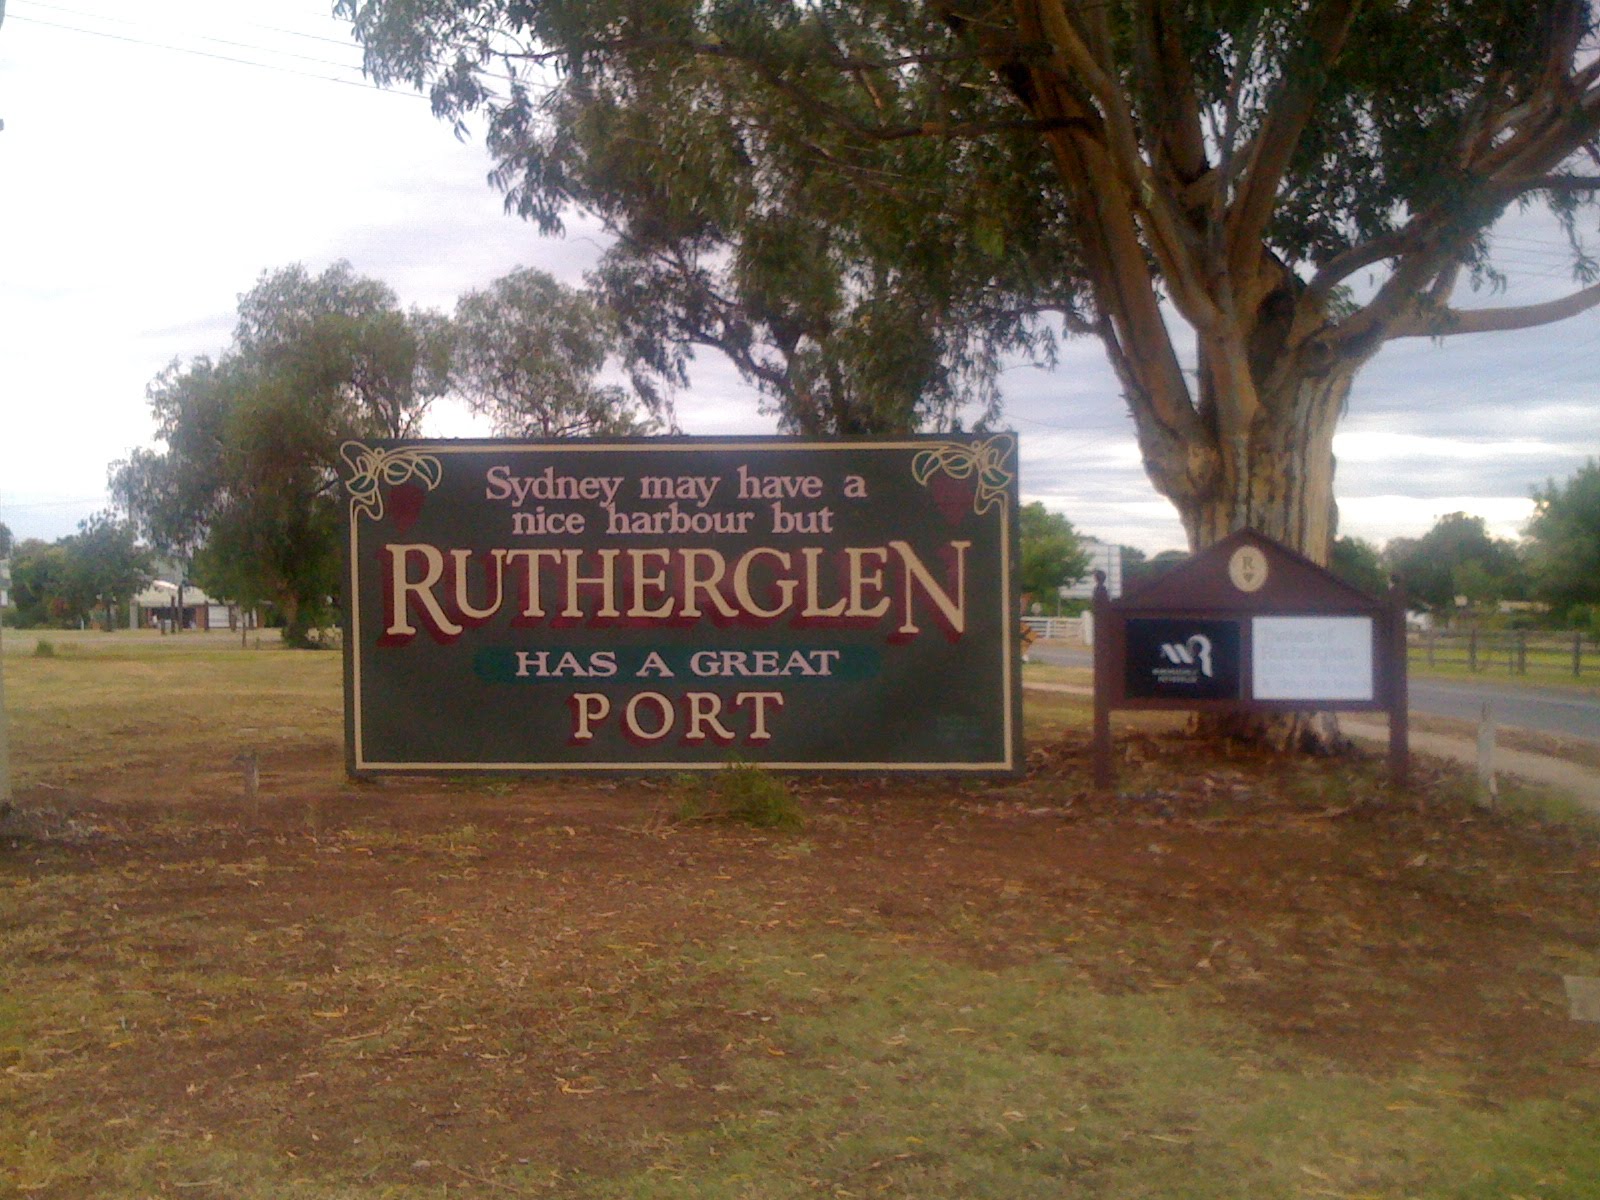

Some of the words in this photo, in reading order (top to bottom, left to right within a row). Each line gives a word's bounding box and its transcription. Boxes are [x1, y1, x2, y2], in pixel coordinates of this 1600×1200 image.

[486, 465, 624, 507] Sydney
[640, 476, 721, 507] may
[737, 464, 823, 498] have
[844, 476, 868, 498] a
[512, 503, 585, 534] nice
[606, 503, 754, 534] harbour
[771, 502, 834, 533] but
[386, 541, 971, 635] RUTHERGLEN
[516, 652, 617, 677] HAS
[636, 652, 674, 677] A
[690, 651, 839, 677] GREAT
[574, 692, 783, 738] PORT
